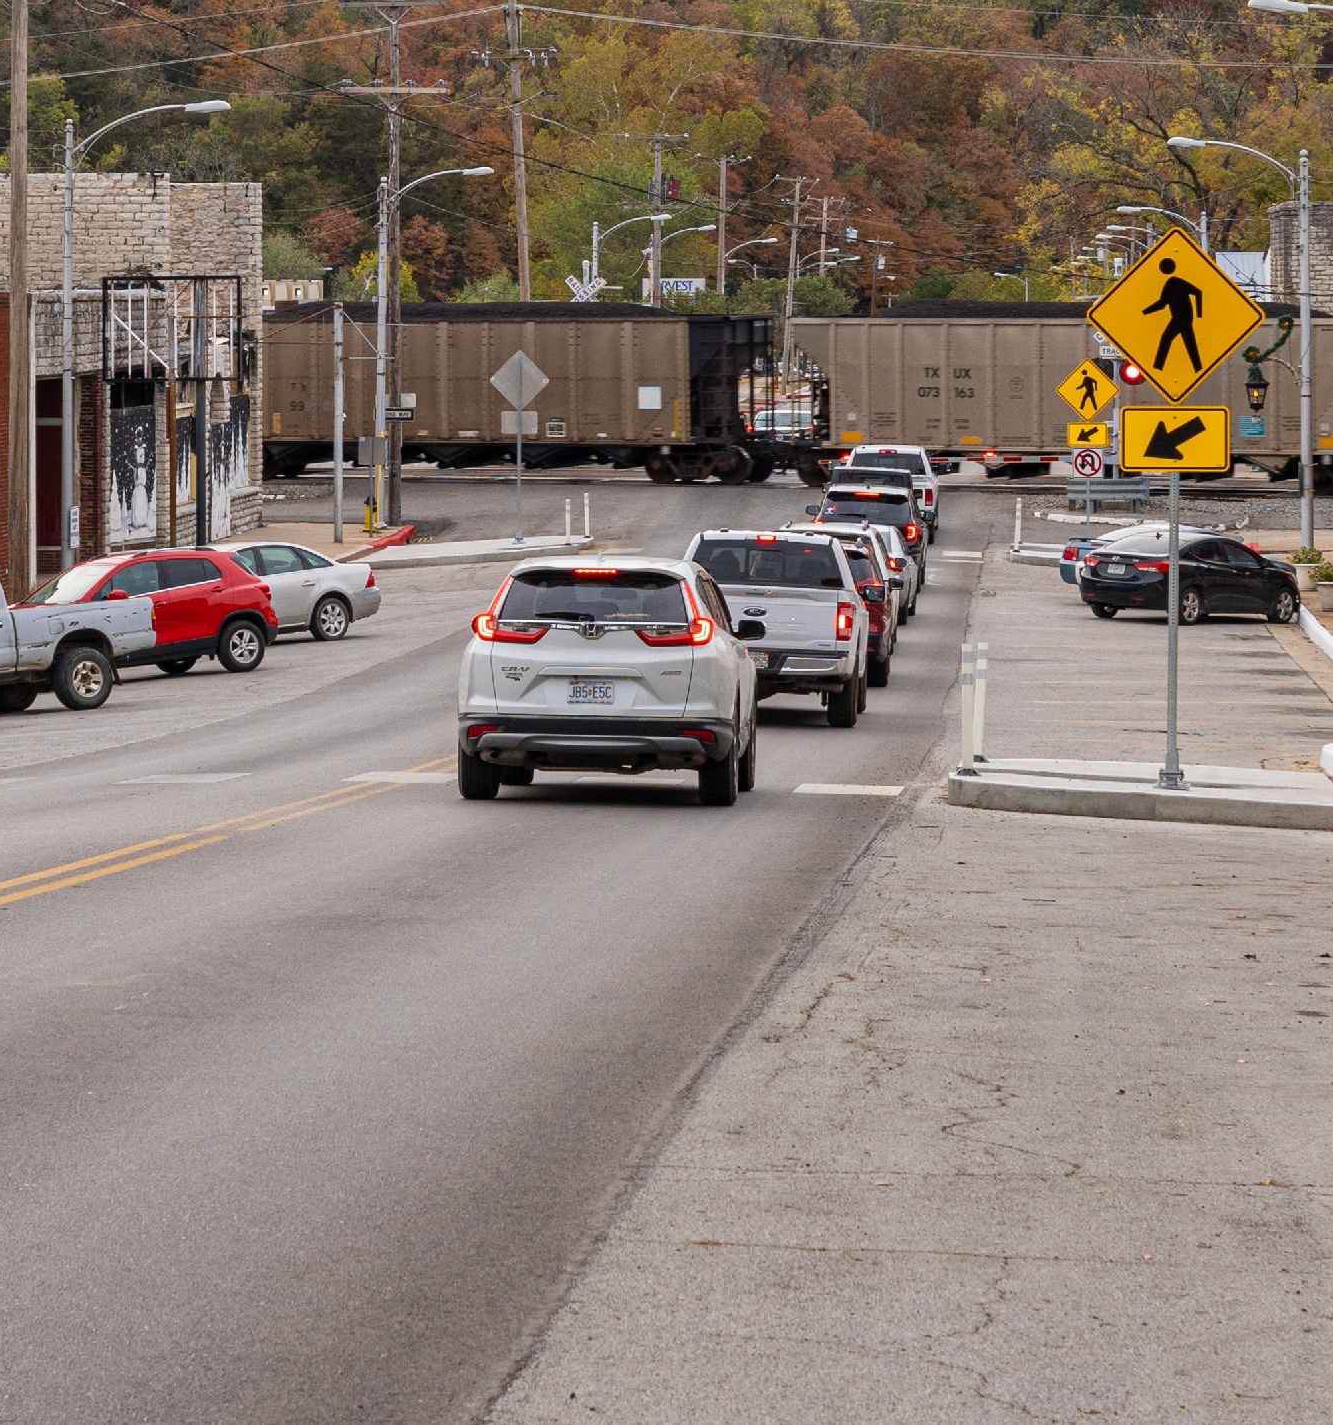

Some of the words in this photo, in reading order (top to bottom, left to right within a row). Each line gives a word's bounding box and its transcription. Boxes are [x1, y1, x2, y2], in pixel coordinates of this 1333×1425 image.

[924, 367, 941, 378] TX
[953, 367, 973, 380] UX
[917, 387, 941, 398] 073
[954, 387, 975, 399] 163
[569, 686, 589, 699] JB5
[592, 686, 612, 699] E5C
